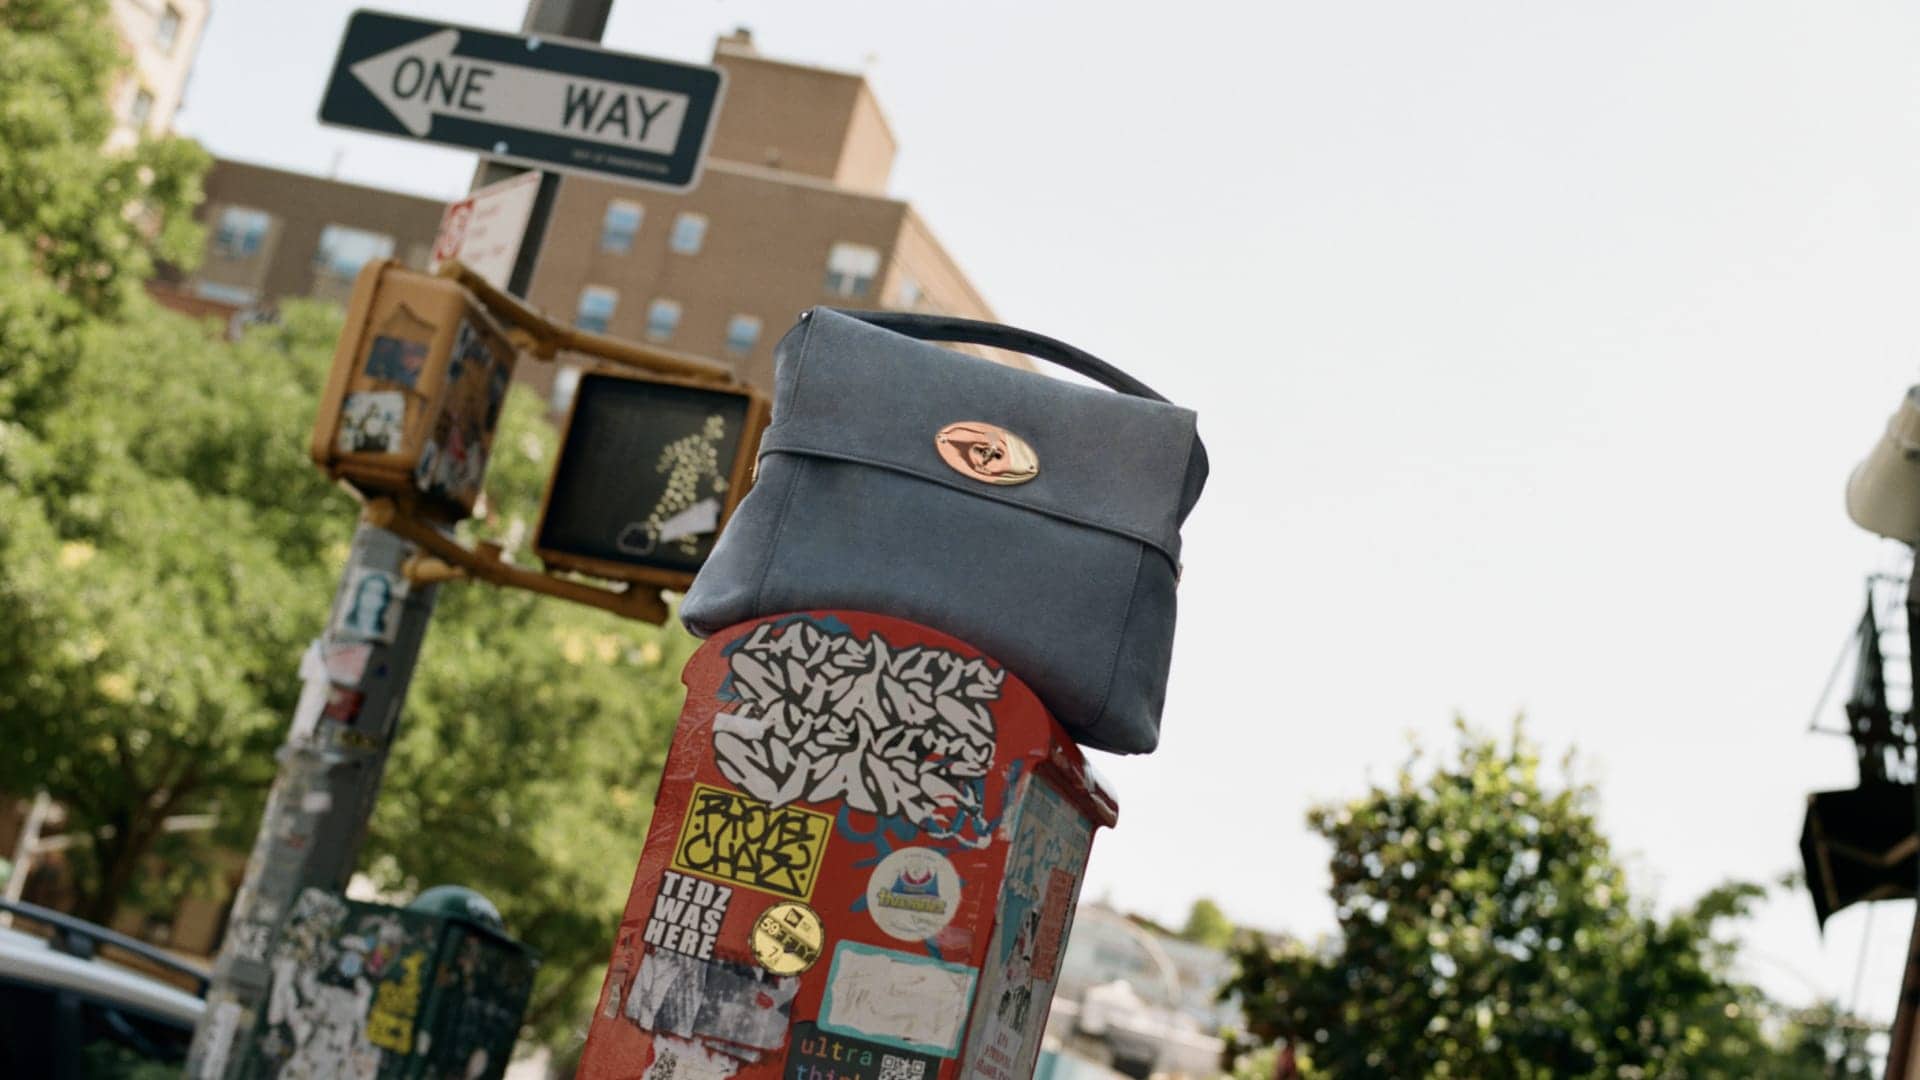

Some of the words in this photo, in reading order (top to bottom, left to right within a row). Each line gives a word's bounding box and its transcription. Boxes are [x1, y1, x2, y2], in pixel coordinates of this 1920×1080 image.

[391, 56, 496, 112] ONE
[562, 83, 671, 142] WAY
[661, 871, 733, 912] TEDZ
[653, 895, 723, 936] WAS
[644, 919, 717, 960] HERE
[801, 1036, 873, 1066] ultra
